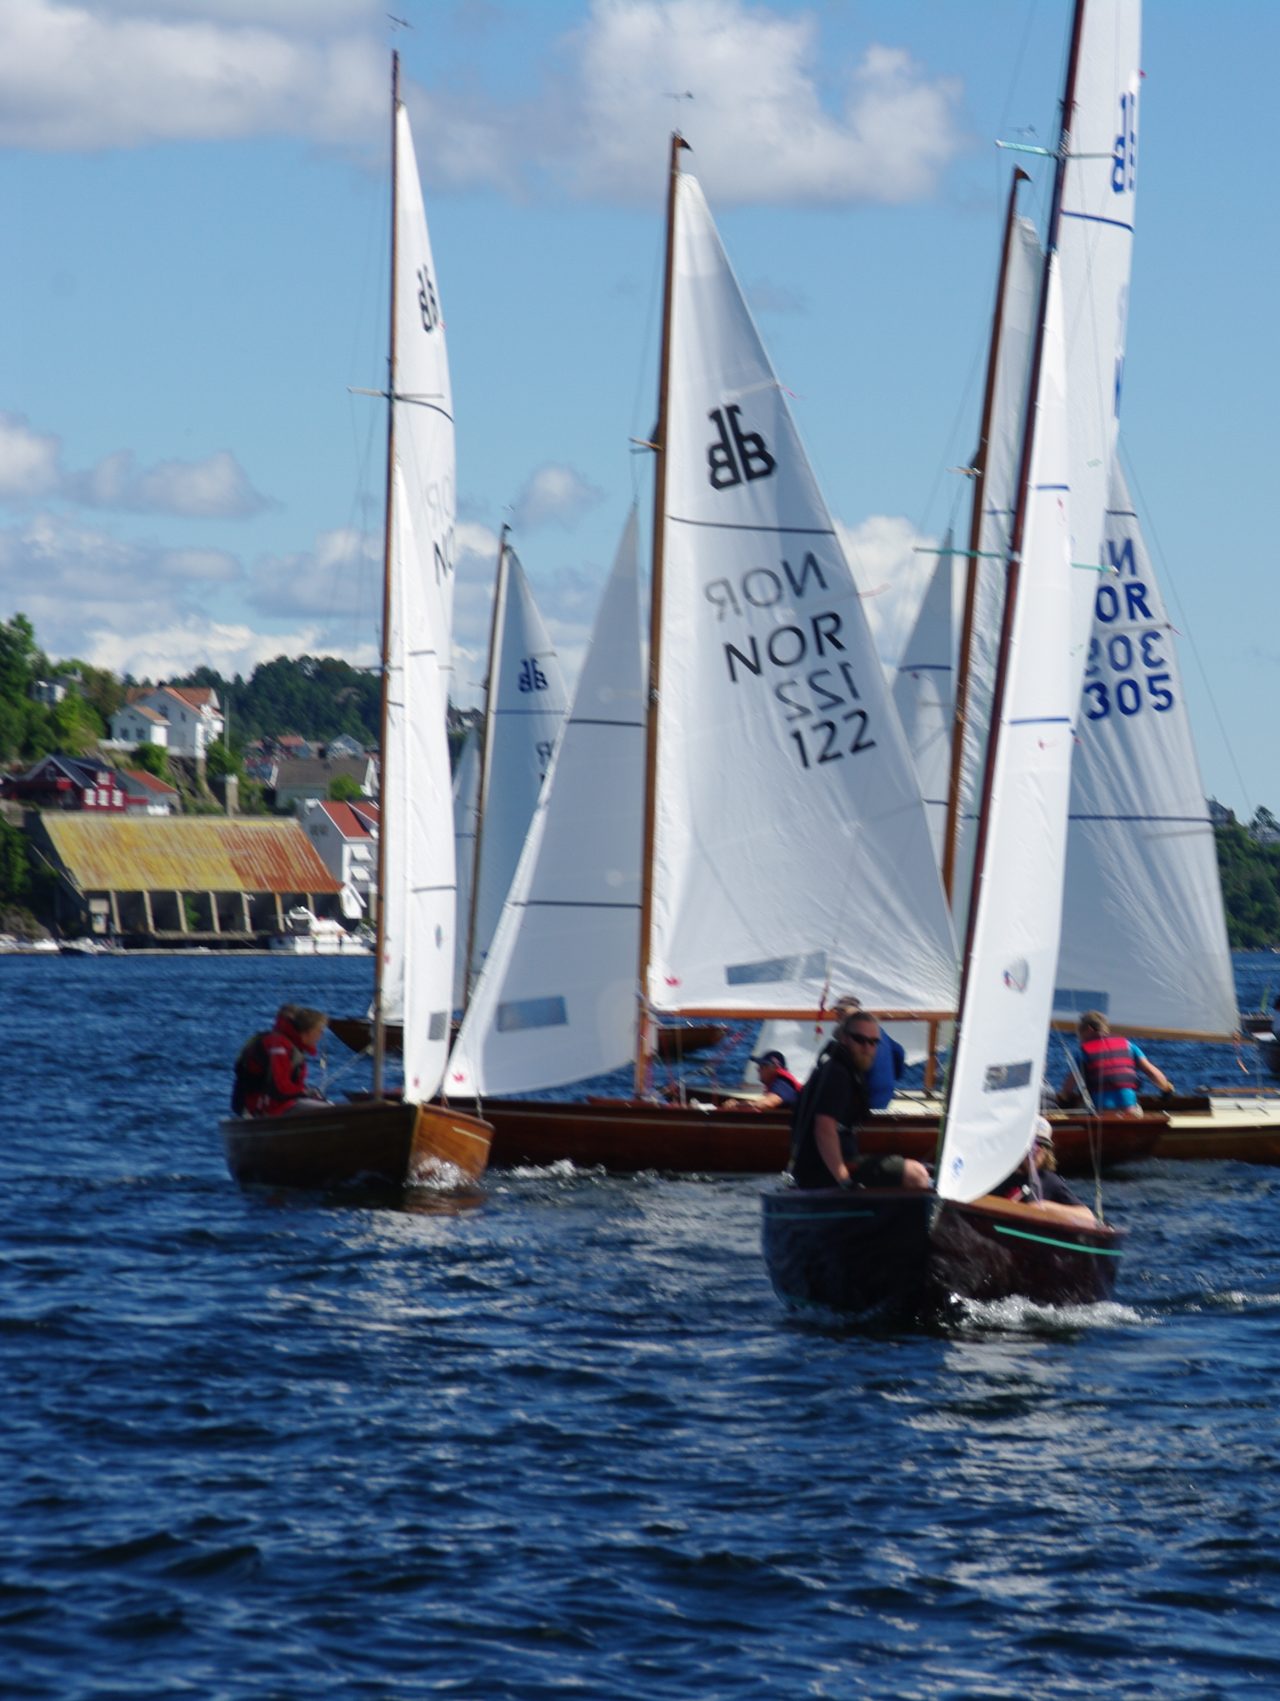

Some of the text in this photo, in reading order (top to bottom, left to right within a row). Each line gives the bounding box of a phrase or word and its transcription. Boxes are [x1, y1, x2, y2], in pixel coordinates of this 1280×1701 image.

[1095, 581, 1154, 623] OR
[723, 611, 847, 683] NOR
[1084, 673, 1174, 721] 305
[789, 709, 876, 769] 122
